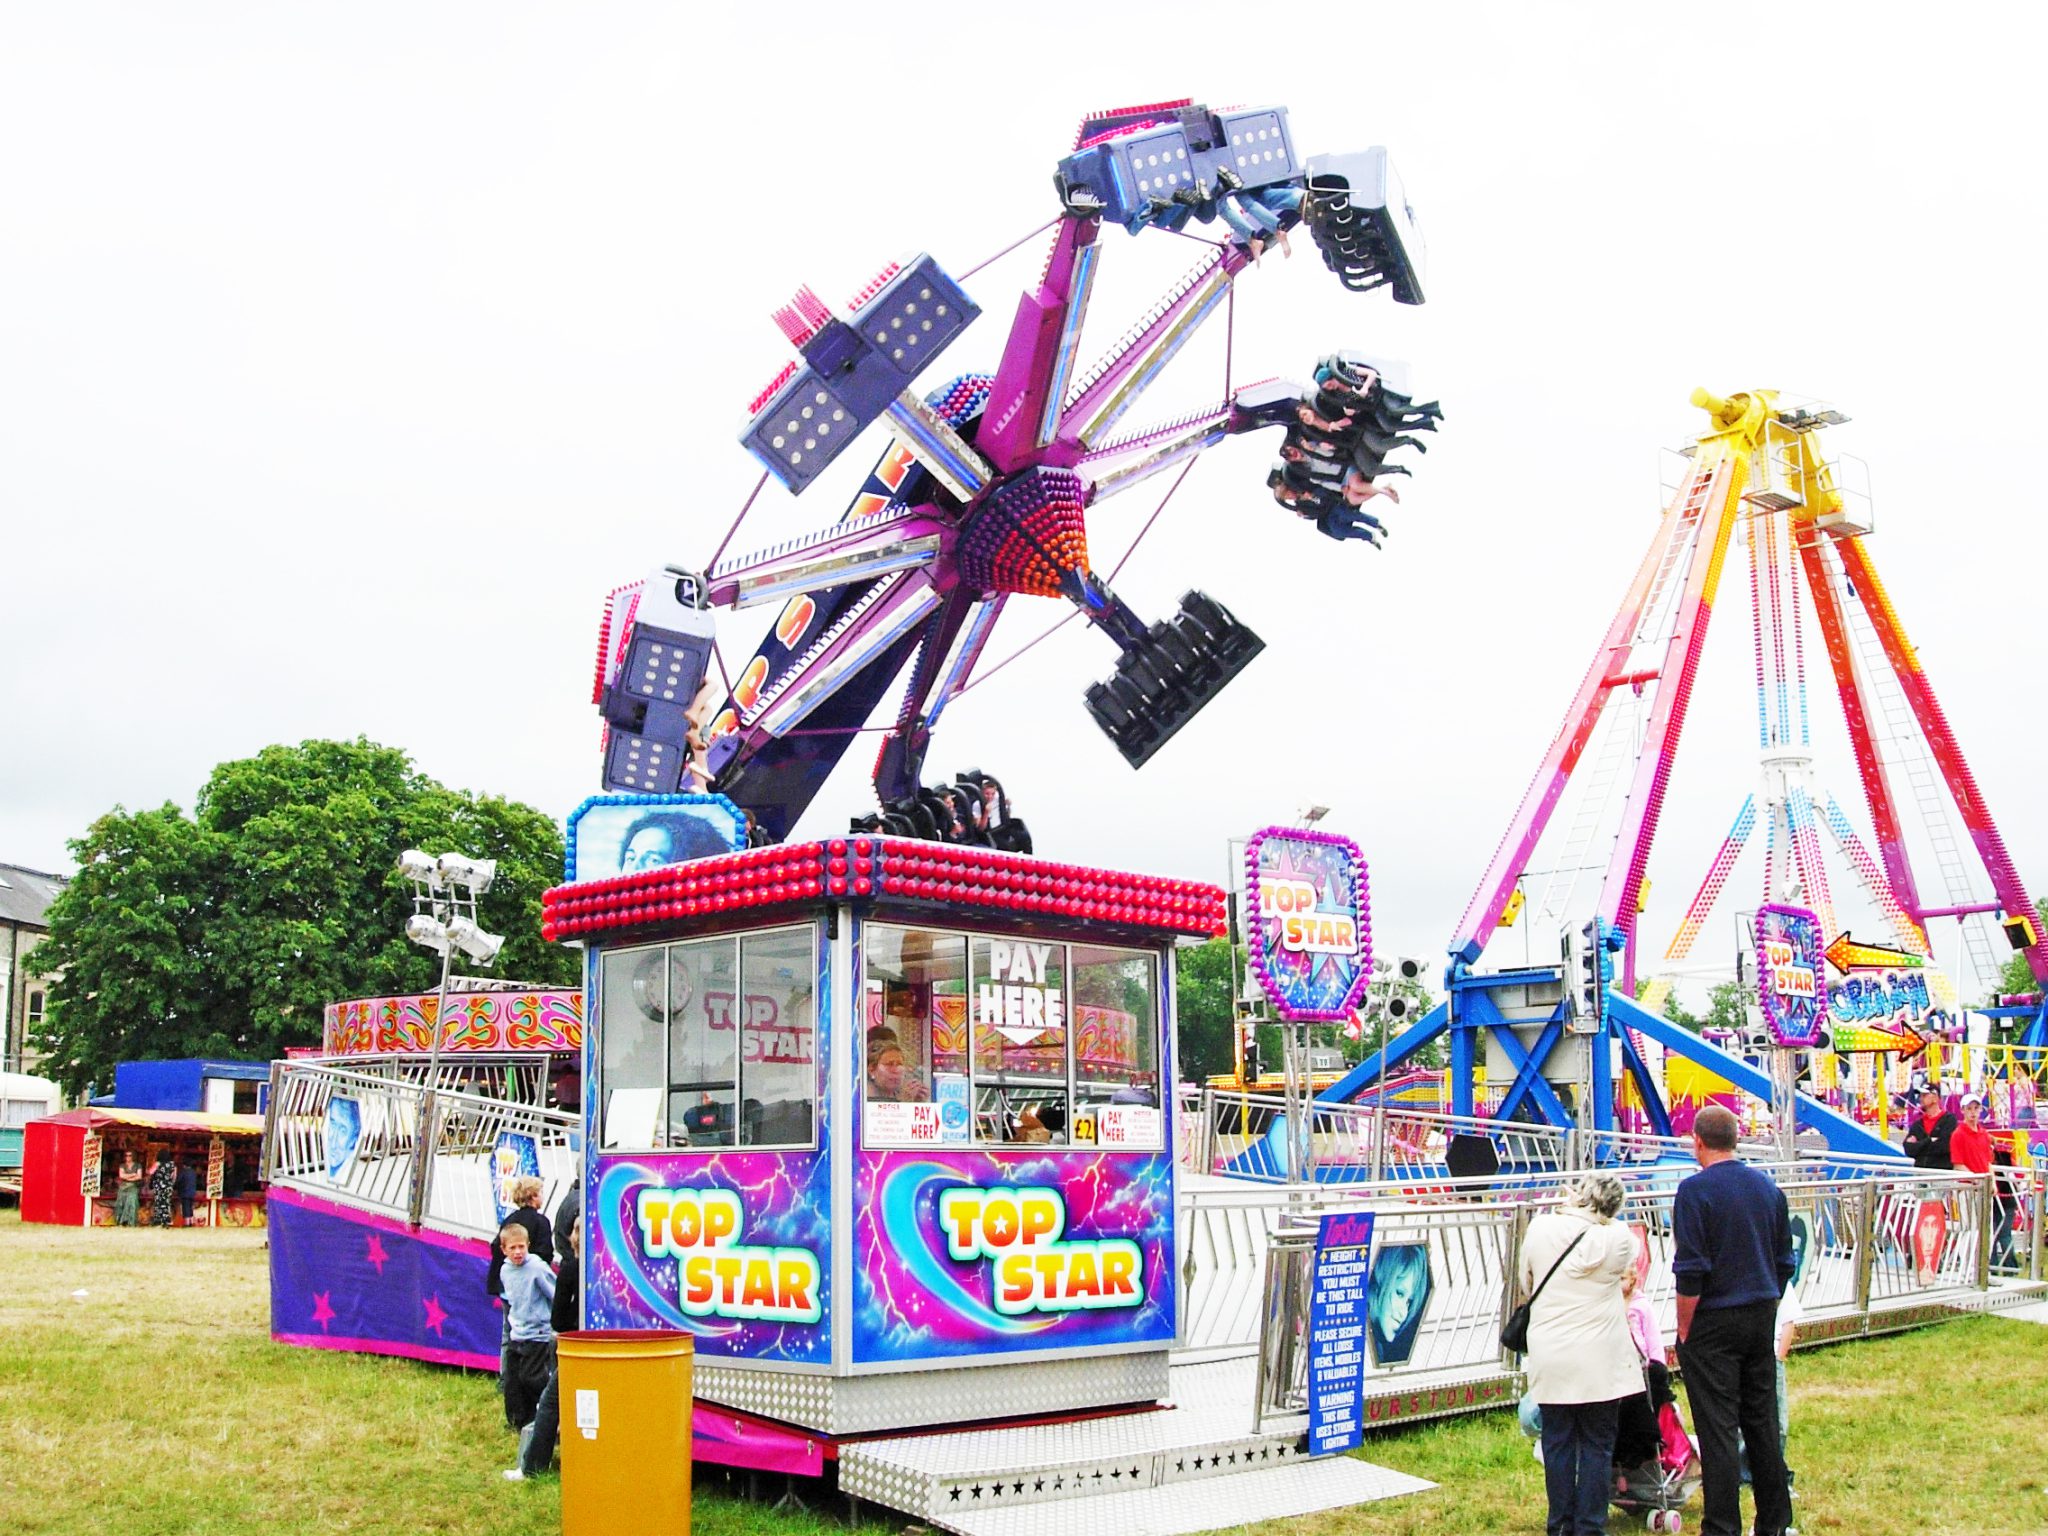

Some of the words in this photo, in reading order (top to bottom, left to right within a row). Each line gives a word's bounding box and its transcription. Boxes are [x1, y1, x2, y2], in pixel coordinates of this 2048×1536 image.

[1260, 884, 1313, 913] TOP
[1286, 917, 1353, 947] STAR
[990, 940, 1053, 983] PAY
[1765, 945, 1791, 967] OP
[1777, 969, 1813, 992] STAR
[979, 983, 1062, 1028] HERE
[914, 1106, 931, 1121] PAY
[1108, 1111, 1122, 1125] PAY
[911, 1124, 933, 1139] HERE
[1075, 1118, 1093, 1140] £2
[1106, 1127, 1125, 1142] HERE
[644, 1200, 735, 1248] TOP
[949, 1199, 1056, 1247] TOP
[1330, 1250, 1357, 1262] HEIGHT
[1002, 1251, 1135, 1302] STAR
[1318, 1262, 1366, 1277] RESTRICTION
[686, 1256, 812, 1310] STAR
[1322, 1277, 1338, 1290] YOU
[1339, 1275, 1361, 1288] MUST
[1316, 1291, 1327, 1304] BE
[1328, 1289, 1345, 1302] THIS
[1347, 1288, 1364, 1300] TALL
[1325, 1303, 1336, 1316] TO
[1336, 1302, 1354, 1315] RIDE
[1314, 1328, 1338, 1342] PLEASE
[1338, 1325, 1362, 1339] SECURE
[1322, 1342, 1333, 1354] ALL
[1334, 1340, 1354, 1353] LOOSE
[1323, 1365, 1358, 1380] VALUABLES
[1319, 1390, 1355, 1408] WARNING
[1322, 1410, 1336, 1424] THIS
[1337, 1408, 1351, 1421] RIDE
